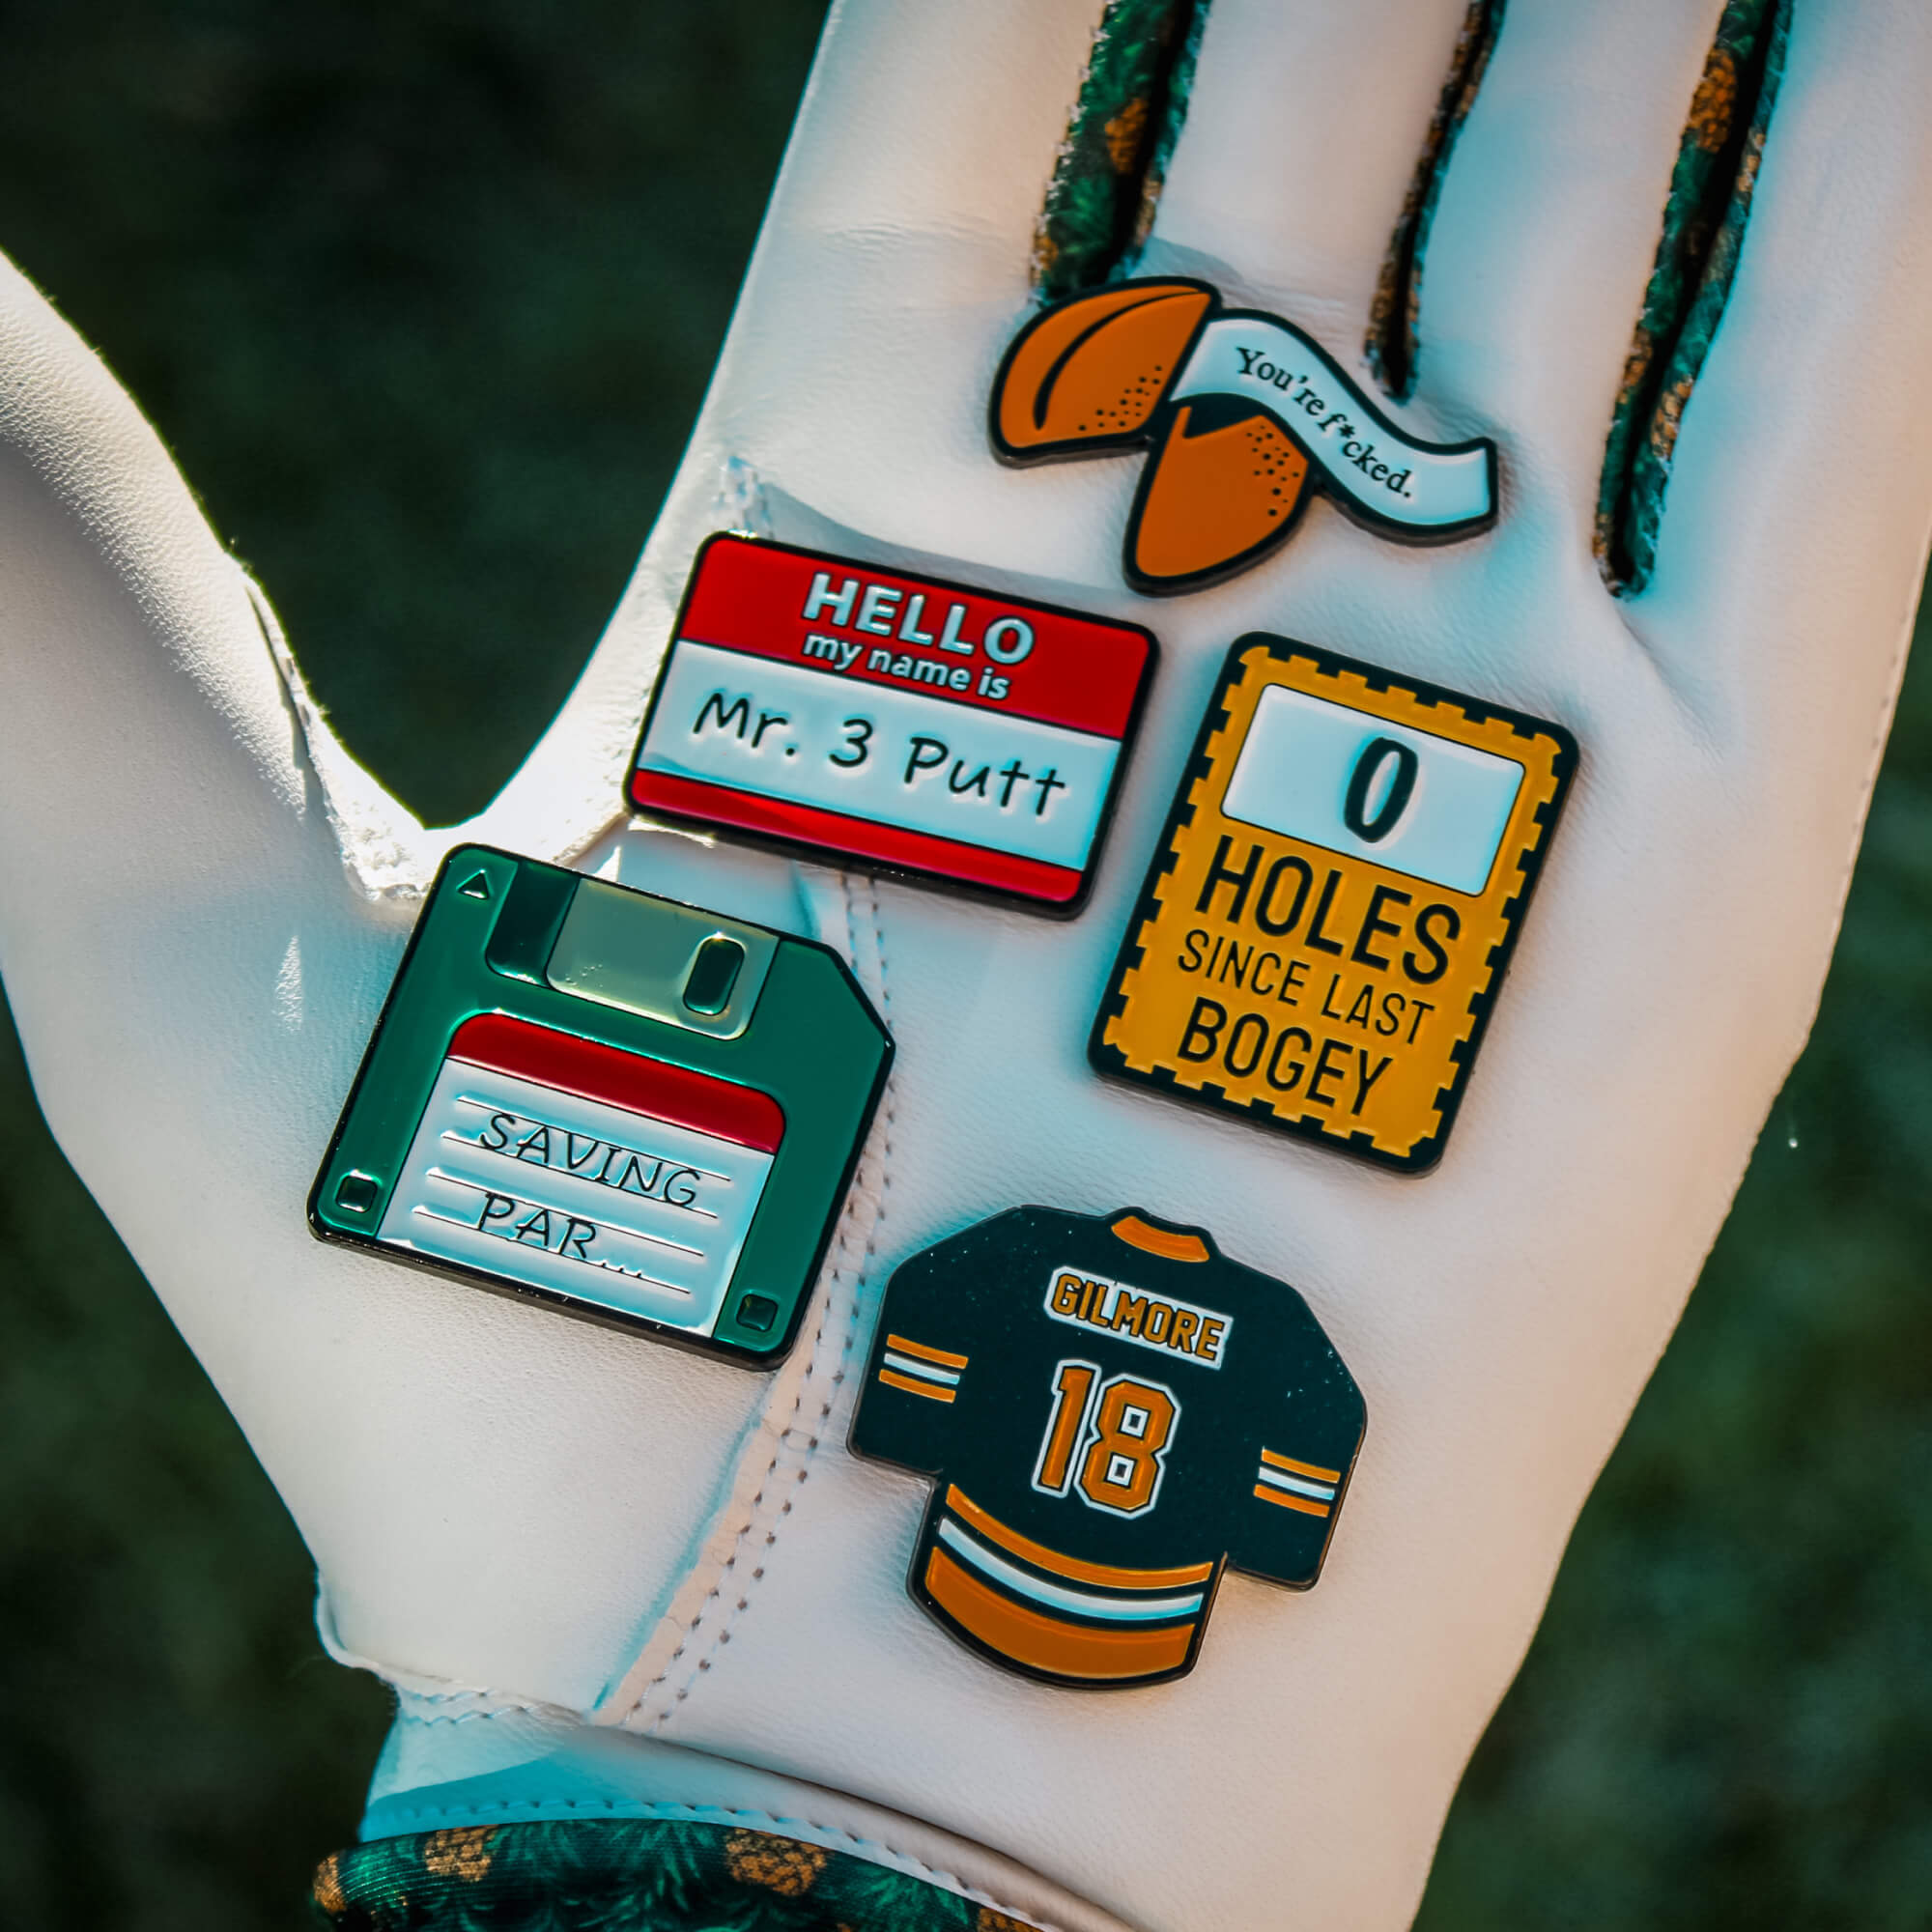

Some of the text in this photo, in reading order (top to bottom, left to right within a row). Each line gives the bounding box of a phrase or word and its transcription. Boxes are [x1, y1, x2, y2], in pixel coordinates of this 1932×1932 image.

[1236, 347, 1325, 416] You're
[801, 572, 1036, 665] HELLO
[802, 633, 1010, 699] my name is
[692, 692, 1066, 815] Mr. 3 Putt
[1344, 736, 1419, 843] 0
[1194, 834, 1462, 985] HOLES
[1178, 928, 1435, 1044] SINCE LAST
[1177, 995, 1394, 1117] BOGEY
[479, 1113, 701, 1207] SAVING
[1048, 1271, 1228, 1363] GILMORE
[1032, 1358, 1181, 1520] 18
